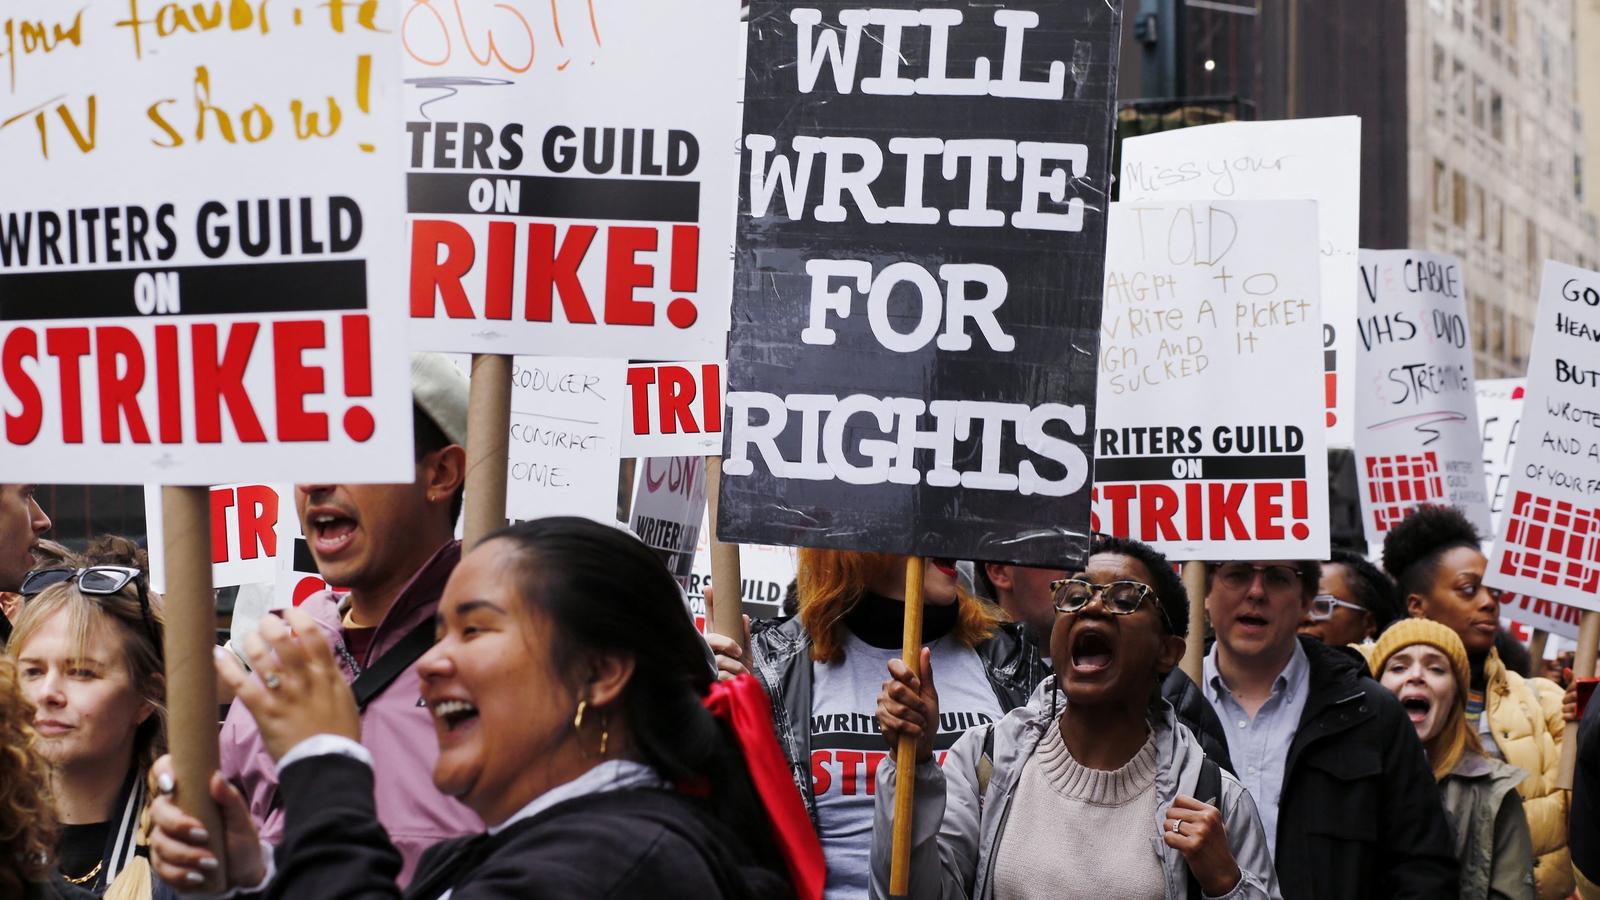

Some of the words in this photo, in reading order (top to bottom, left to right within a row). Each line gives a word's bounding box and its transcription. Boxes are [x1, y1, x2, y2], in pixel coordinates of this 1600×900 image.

[790, 8, 1065, 100] WILL
[0, 94, 97, 160] TV
[147, 54, 376, 153] show!
[406, 121, 523, 170] TERS
[542, 125, 700, 176] GUILD
[468, 178, 521, 213] ON
[745, 133, 1088, 232] WRITE
[1125, 160, 1201, 191] Miss
[1207, 153, 1300, 196] your
[0, 203, 177, 267] WRITERS
[196, 196, 363, 259] GUILD
[134, 271, 181, 315] ON
[410, 219, 700, 329] RIKE!
[1403, 258, 1458, 298] CABLE
[801, 259, 1015, 353] FOR
[1198, 300, 1217, 329] A
[1357, 311, 1416, 352] VHS
[2, 314, 375, 446] STRIKE!
[1556, 359, 1600, 388] BUT
[1546, 396, 1600, 429] WROTE
[511, 423, 606, 451] CONTRACT
[722, 391, 1088, 497] RIGHTS
[1095, 426, 1203, 456] RITERS
[1213, 425, 1304, 453] GUILD
[1541, 431, 1581, 455] AND
[1172, 458, 1203, 479] ON
[1526, 464, 1544, 481] OF
[1547, 469, 1583, 493] YOUR
